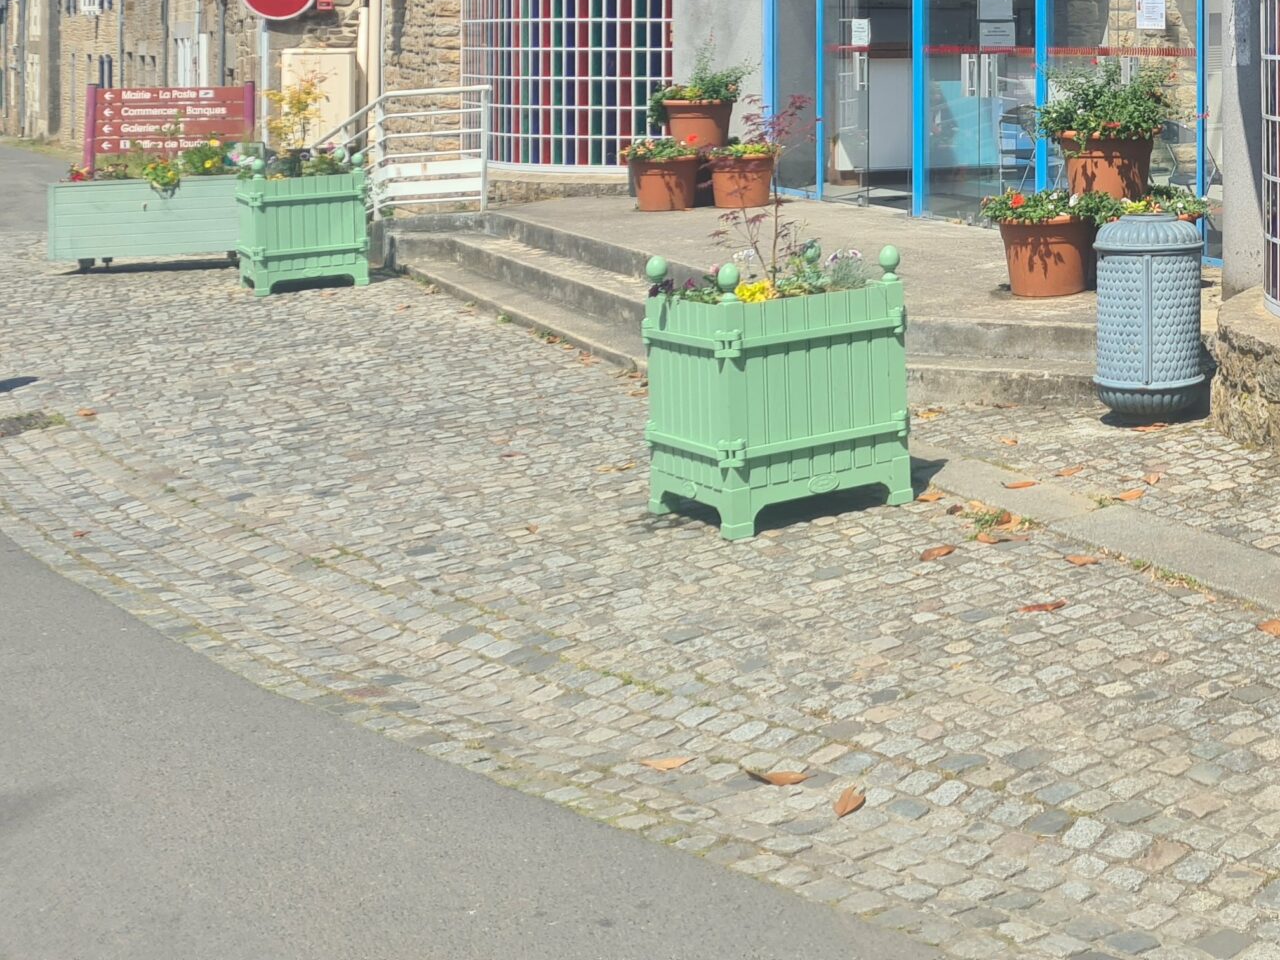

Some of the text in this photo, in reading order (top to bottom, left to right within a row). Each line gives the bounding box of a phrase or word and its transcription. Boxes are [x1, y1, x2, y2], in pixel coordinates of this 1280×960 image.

[121, 90, 152, 100] Mairie
[158, 90, 171, 99] La
[171, 90, 198, 99] Poste
[120, 107, 178, 116] Commerces
[185, 106, 227, 116] Banques
[164, 140, 179, 148] de
[179, 139, 220, 148] Touri
